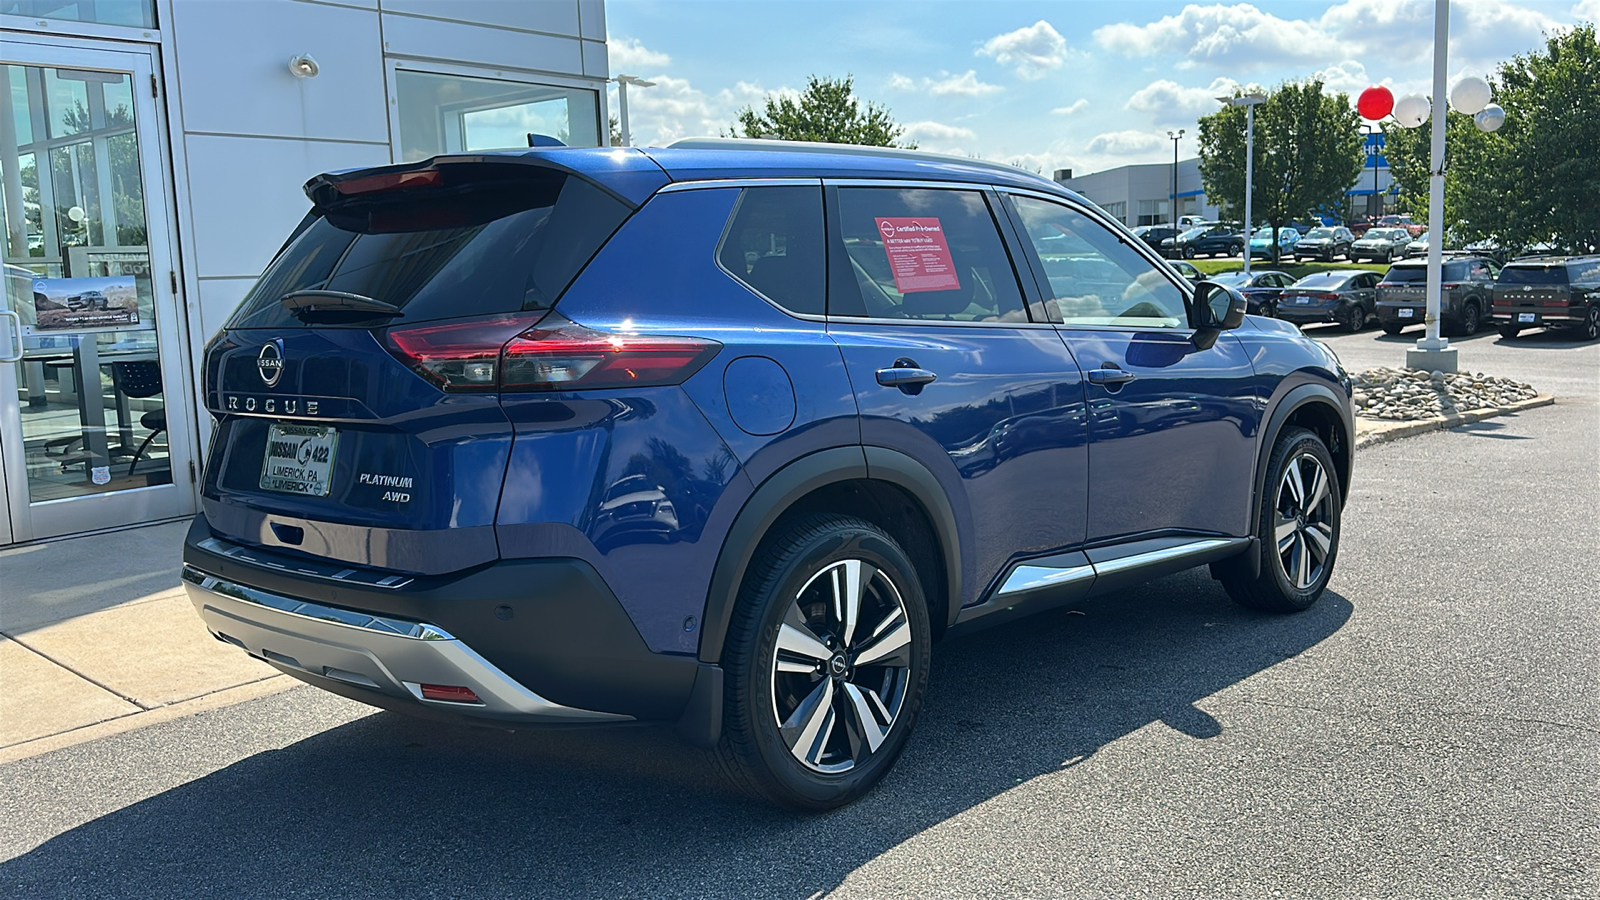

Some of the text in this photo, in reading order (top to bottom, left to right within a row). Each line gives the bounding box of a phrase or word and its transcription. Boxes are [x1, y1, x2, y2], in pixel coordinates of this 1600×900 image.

[228, 396, 319, 415] ROGUE
[269, 441, 330, 463] NISSAN 422
[360, 473, 413, 488] PLATINUM
[382, 491, 410, 503] AWD
